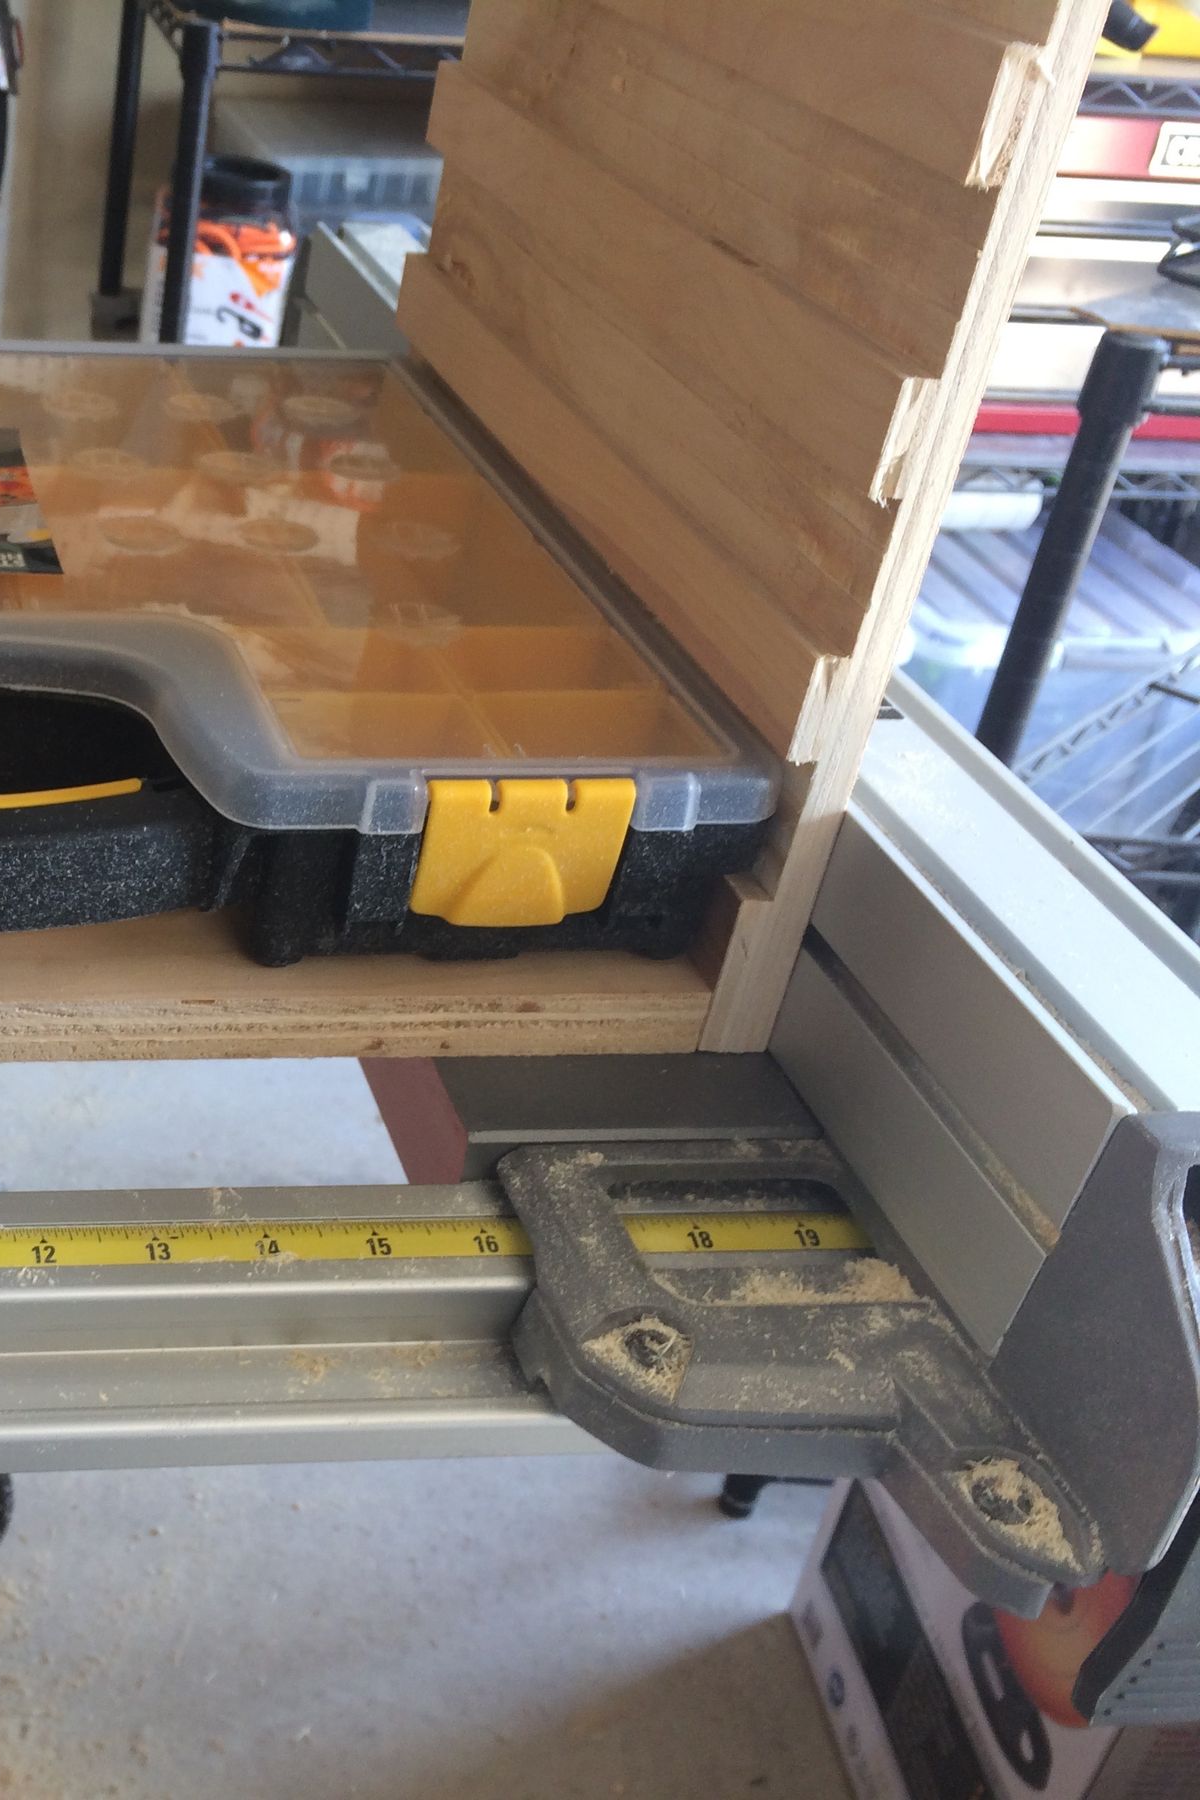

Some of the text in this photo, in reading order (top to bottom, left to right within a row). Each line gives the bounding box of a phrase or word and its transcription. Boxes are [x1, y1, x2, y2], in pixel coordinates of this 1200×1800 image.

[31, 1245, 57, 1264] 12
[145, 1242, 171, 1261] 13
[255, 1240, 280, 1256] 14
[365, 1237, 392, 1256] 15
[473, 1235, 499, 1253] 16
[687, 1231, 714, 1249] 18
[793, 1228, 821, 1247] 19
